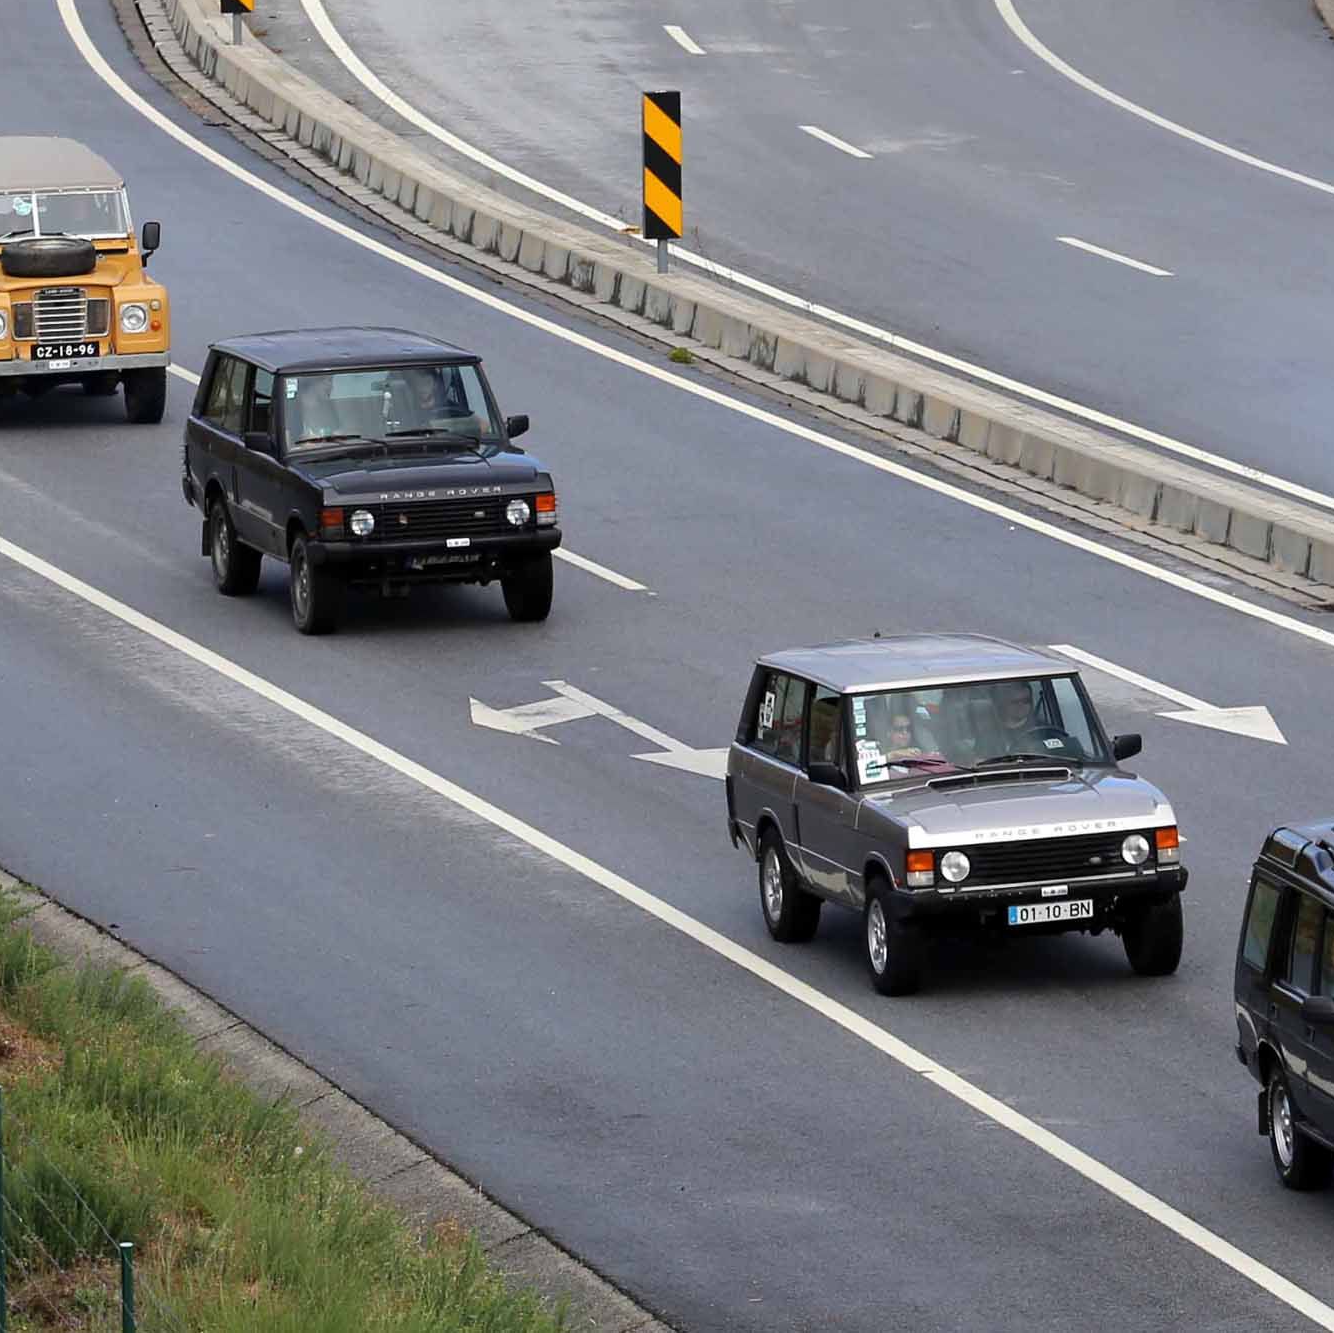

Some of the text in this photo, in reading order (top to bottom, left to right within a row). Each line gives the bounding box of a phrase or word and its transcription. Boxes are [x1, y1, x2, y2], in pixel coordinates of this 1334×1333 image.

[36, 344, 95, 358] CZ-18-96
[379, 485, 502, 501] RANGE ROVER
[974, 820, 1117, 840] RANGE ROVER
